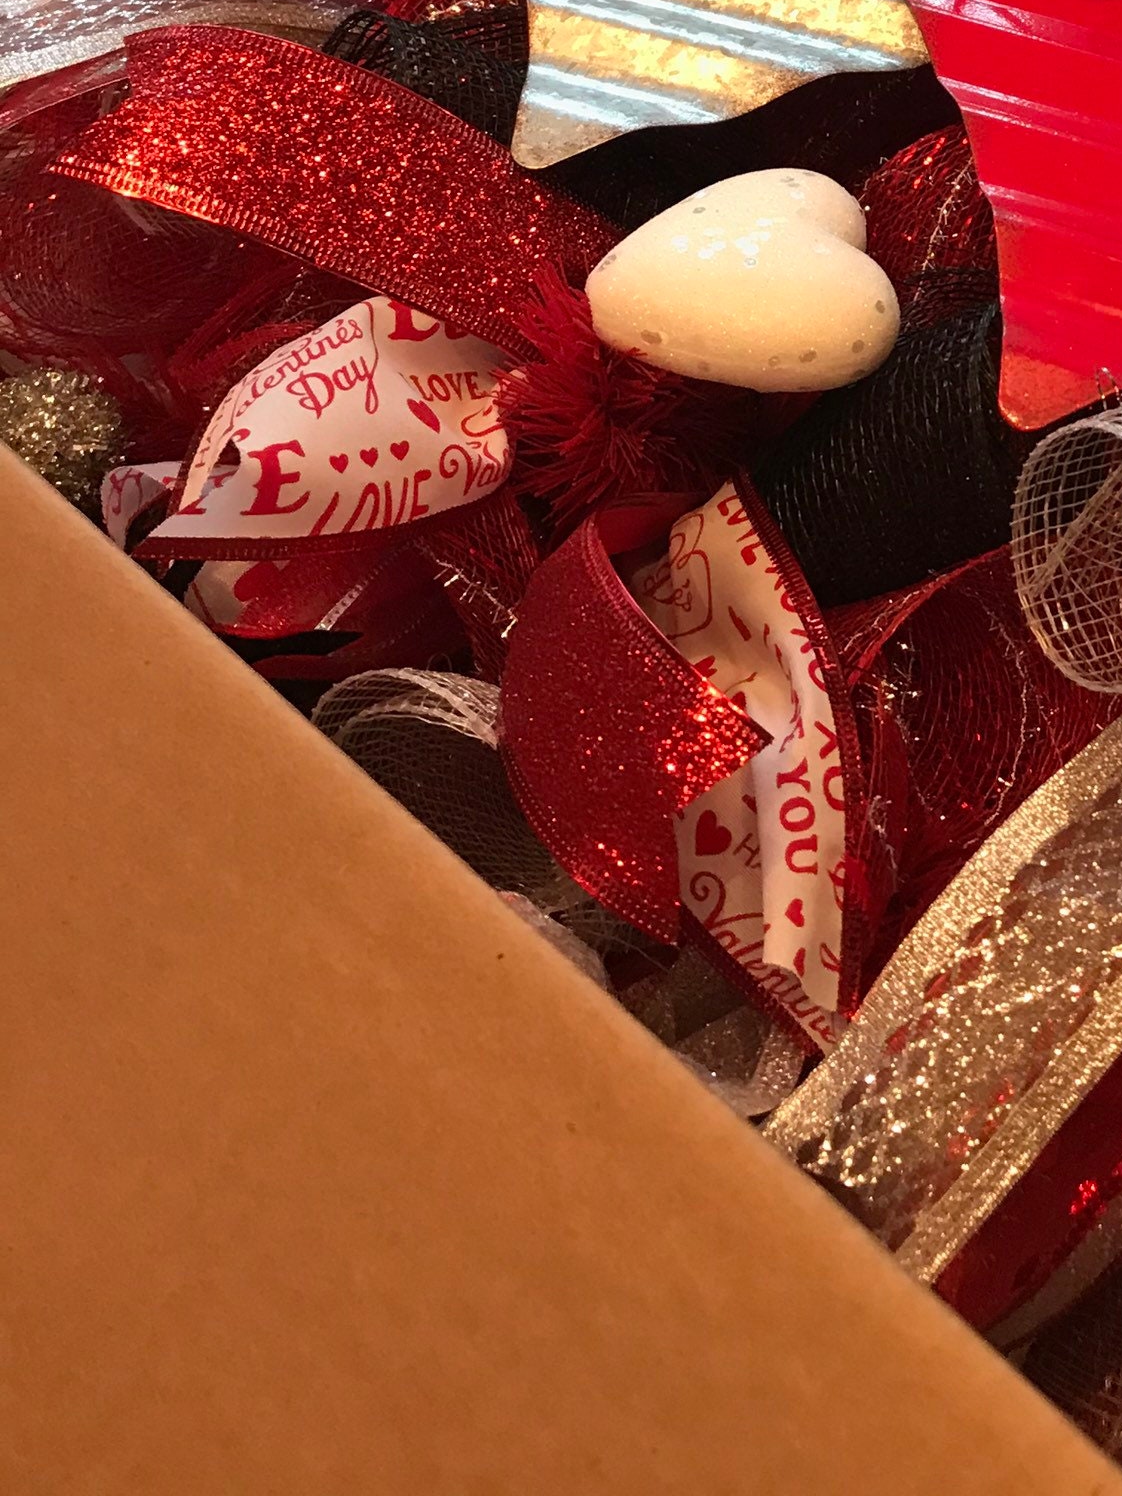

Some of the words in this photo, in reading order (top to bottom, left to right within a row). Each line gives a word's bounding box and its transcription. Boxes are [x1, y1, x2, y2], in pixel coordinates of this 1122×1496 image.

[286, 355, 379, 420] Day
[408, 371, 488, 402] LOVE
[776, 756, 819, 876] YOU
